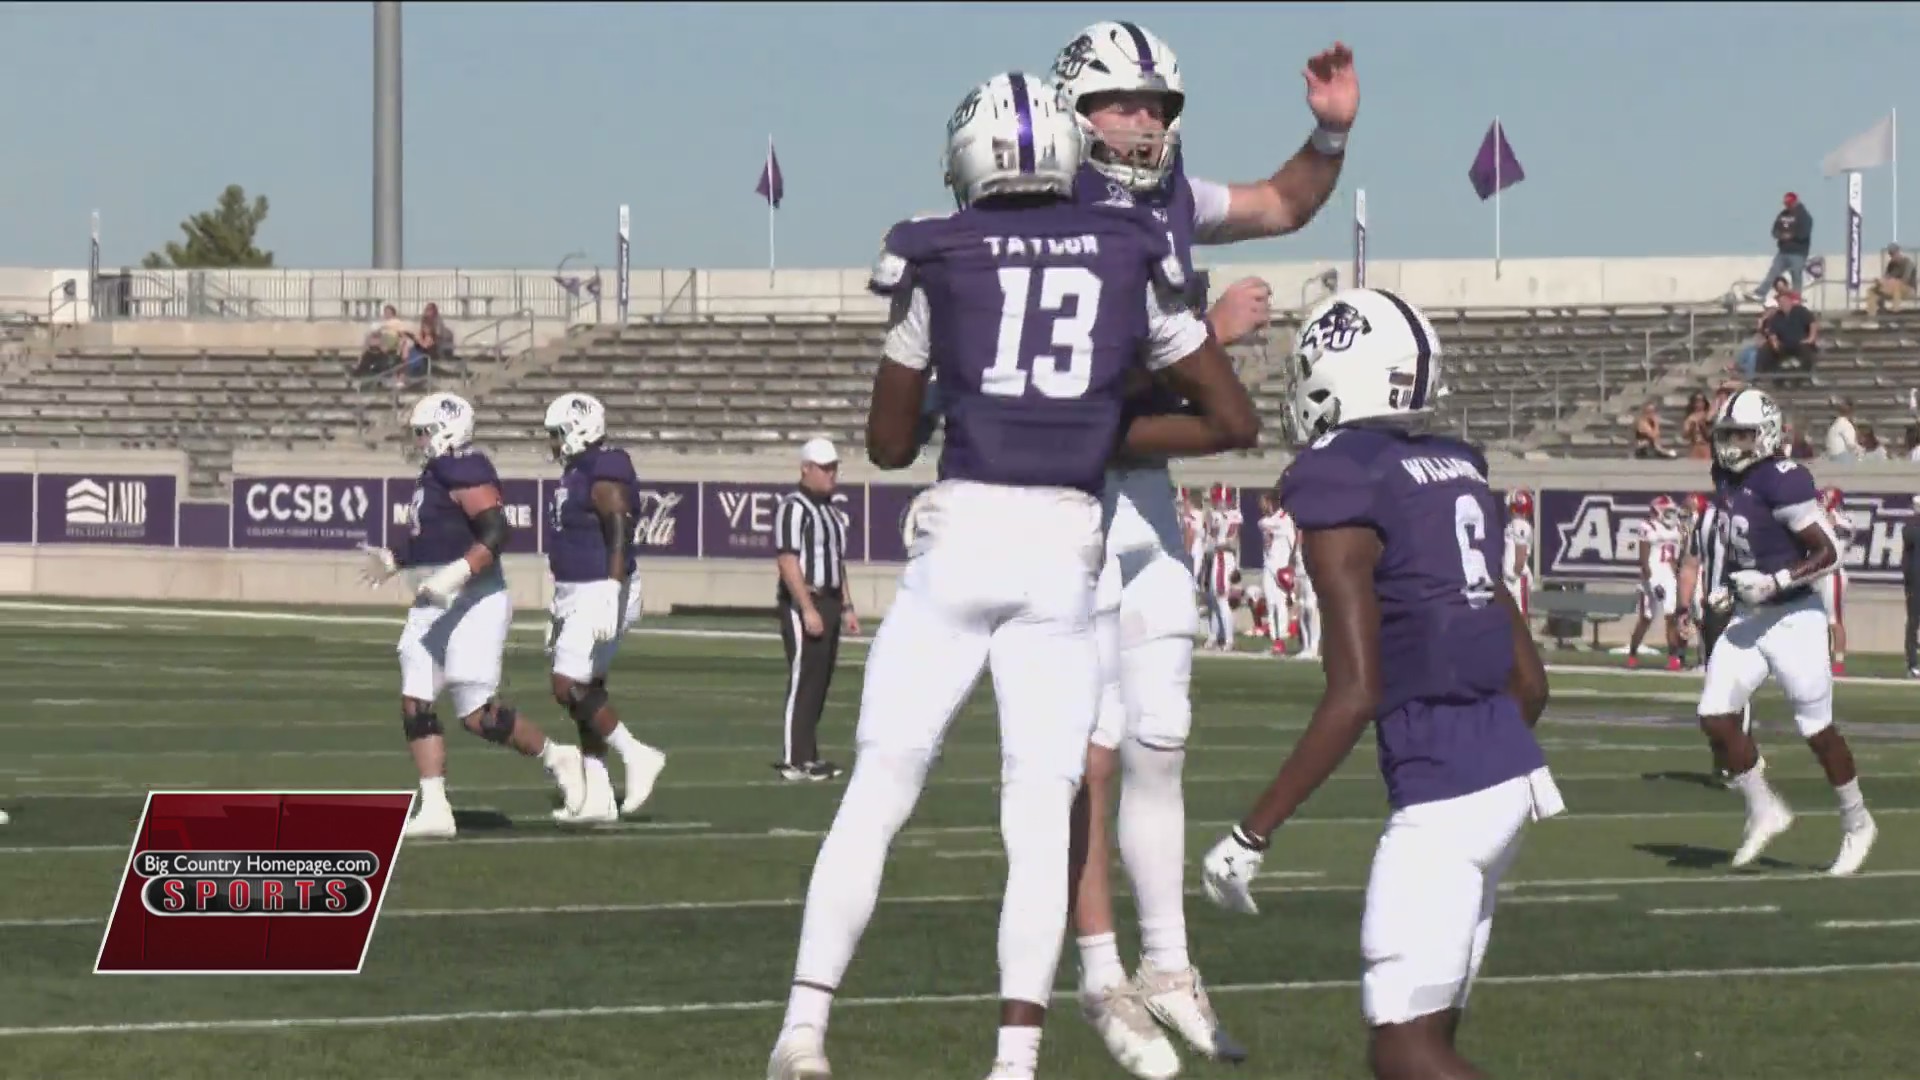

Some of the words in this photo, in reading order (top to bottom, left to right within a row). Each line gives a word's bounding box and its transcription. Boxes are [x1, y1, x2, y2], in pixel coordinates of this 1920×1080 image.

[983, 234, 1098, 256] TAYLOR
[980, 266, 1103, 399] 13
[246, 483, 334, 521] CCSB
[1455, 494, 1495, 609] 6
